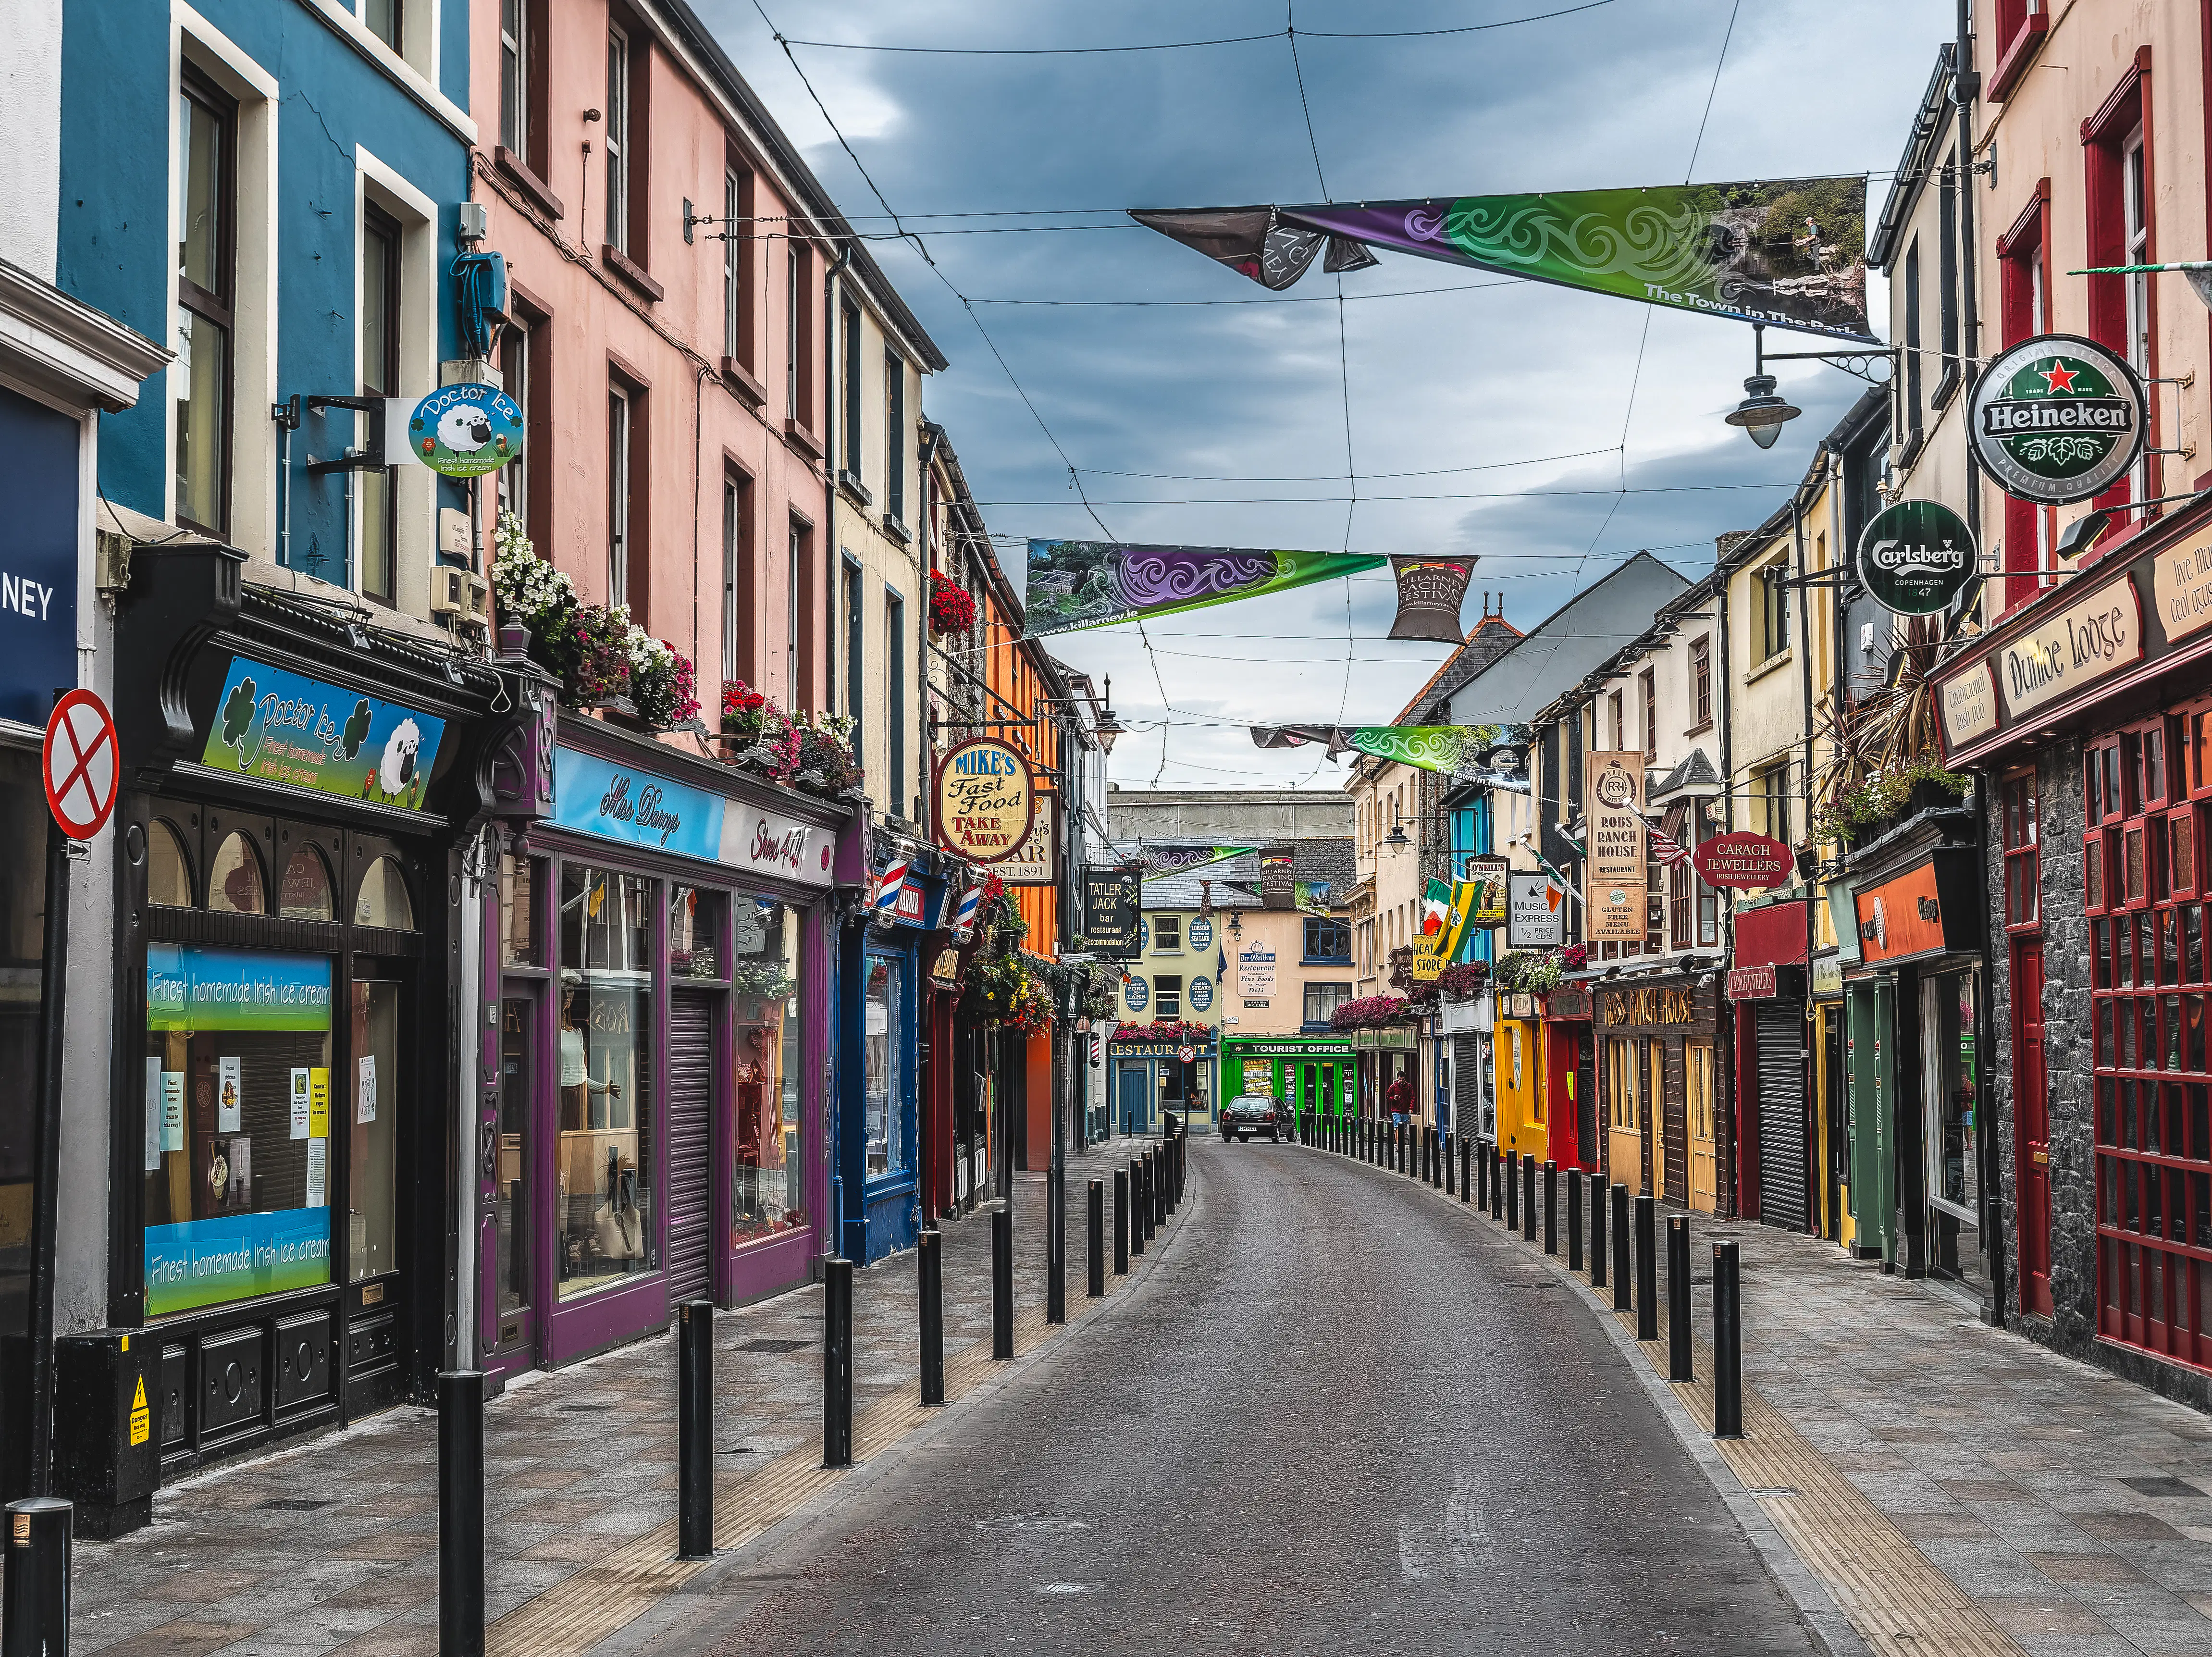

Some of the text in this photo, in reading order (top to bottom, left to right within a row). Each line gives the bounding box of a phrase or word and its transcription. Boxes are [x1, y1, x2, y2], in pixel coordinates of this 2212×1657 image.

[1644, 283, 1858, 335] The Town in The Park
[1997, 345, 2057, 380] ORIGINA
[420, 387, 514, 421] Doctor Ice
[1990, 403, 2126, 430] Heineken
[2066, 457, 2118, 491] QUALITY
[1873, 540, 1965, 572] Carlsberg
[1400, 575, 1463, 590] KILLARNEY
[1908, 588, 1930, 597] 1847
[2, 573, 53, 620] NEY
[1034, 609, 1138, 637] www.killarney.ie
[2067, 606, 2125, 668] Lodge
[259, 692, 339, 744] Doctor Ice
[955, 750, 1016, 776] MIKE'S
[1436, 766, 1451, 776] The
[1453, 769, 1476, 782] Town
[1477, 776, 1485, 784] in
[948, 776, 1005, 798] Fast
[958, 791, 1022, 815] Food
[952, 817, 1001, 833] TAKE
[1601, 817, 1633, 828] ROBS
[960, 830, 1012, 846] AWAY
[1597, 831, 1637, 843] RANCH
[1004, 845, 1048, 864] AR
[1598, 846, 1637, 858] HOUSE
[1717, 844, 1770, 856] CARAGH
[1706, 859, 1781, 872] JEWELLERS
[1089, 883, 1121, 896] TATLER
[898, 889, 919, 914] BARBER
[1093, 897, 1117, 910] JACK
[1515, 902, 1547, 910] MUSIC
[1100, 914, 1113, 922] bar
[1515, 914, 1559, 922] EXPRESS
[1087, 938, 1123, 946] accommodation
[1416, 959, 1442, 972] STORE
[152, 969, 331, 1005] Finest homemade Irish ice cream
[1730, 972, 1772, 993] CARAGH JEWELLERS
[1663, 986, 1694, 1024] HOUSE
[151, 1236, 331, 1285] Finest homemade Irish ice cream
